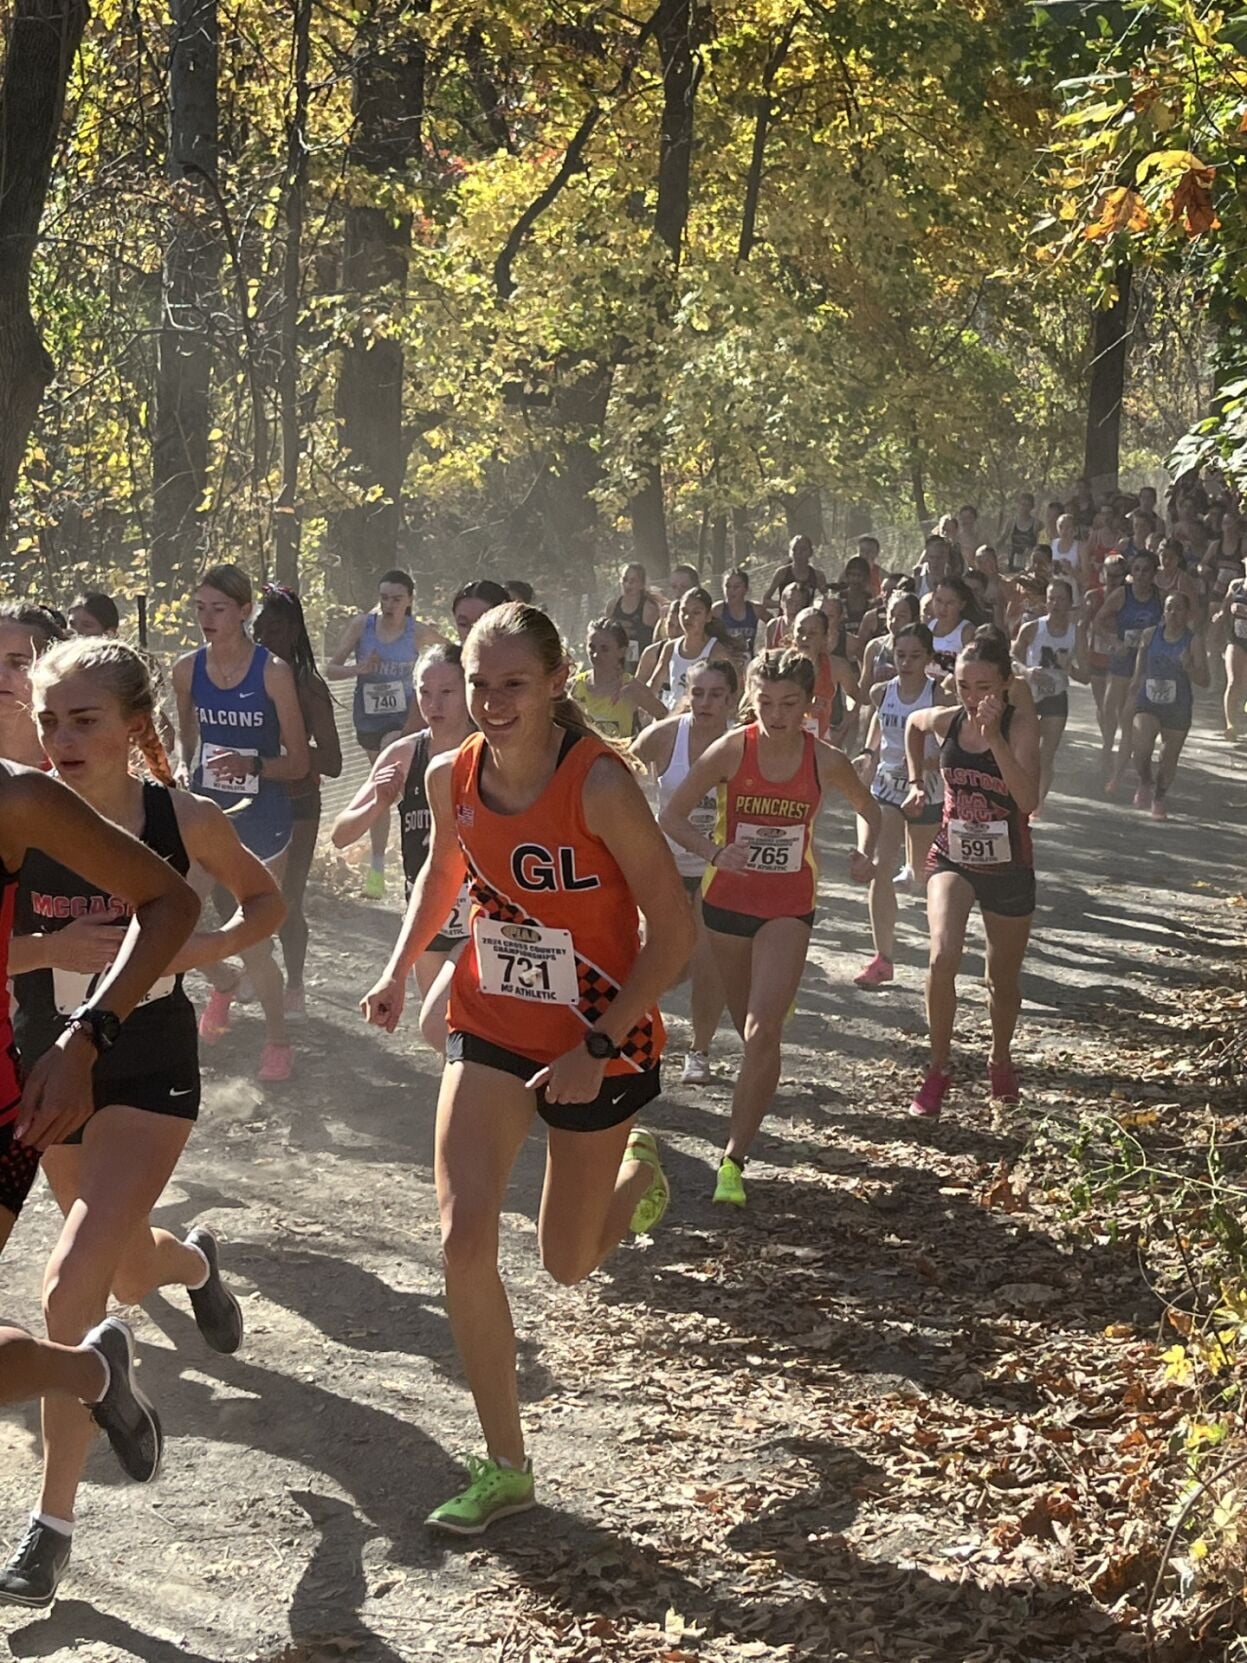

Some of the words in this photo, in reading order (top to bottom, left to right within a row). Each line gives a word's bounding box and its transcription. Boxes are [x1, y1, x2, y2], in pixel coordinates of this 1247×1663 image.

[372, 694, 397, 708] 740
[736, 795, 810, 820] PENNCREST
[749, 845, 789, 866] 765
[961, 839, 995, 857] 591
[510, 843, 601, 893] GL
[492, 945, 557, 961] CHAMPIONSHIPS
[503, 940, 529, 951] CROSS
[529, 944, 566, 955] COUNTRY
[514, 986, 557, 1001] ATHLETIC
